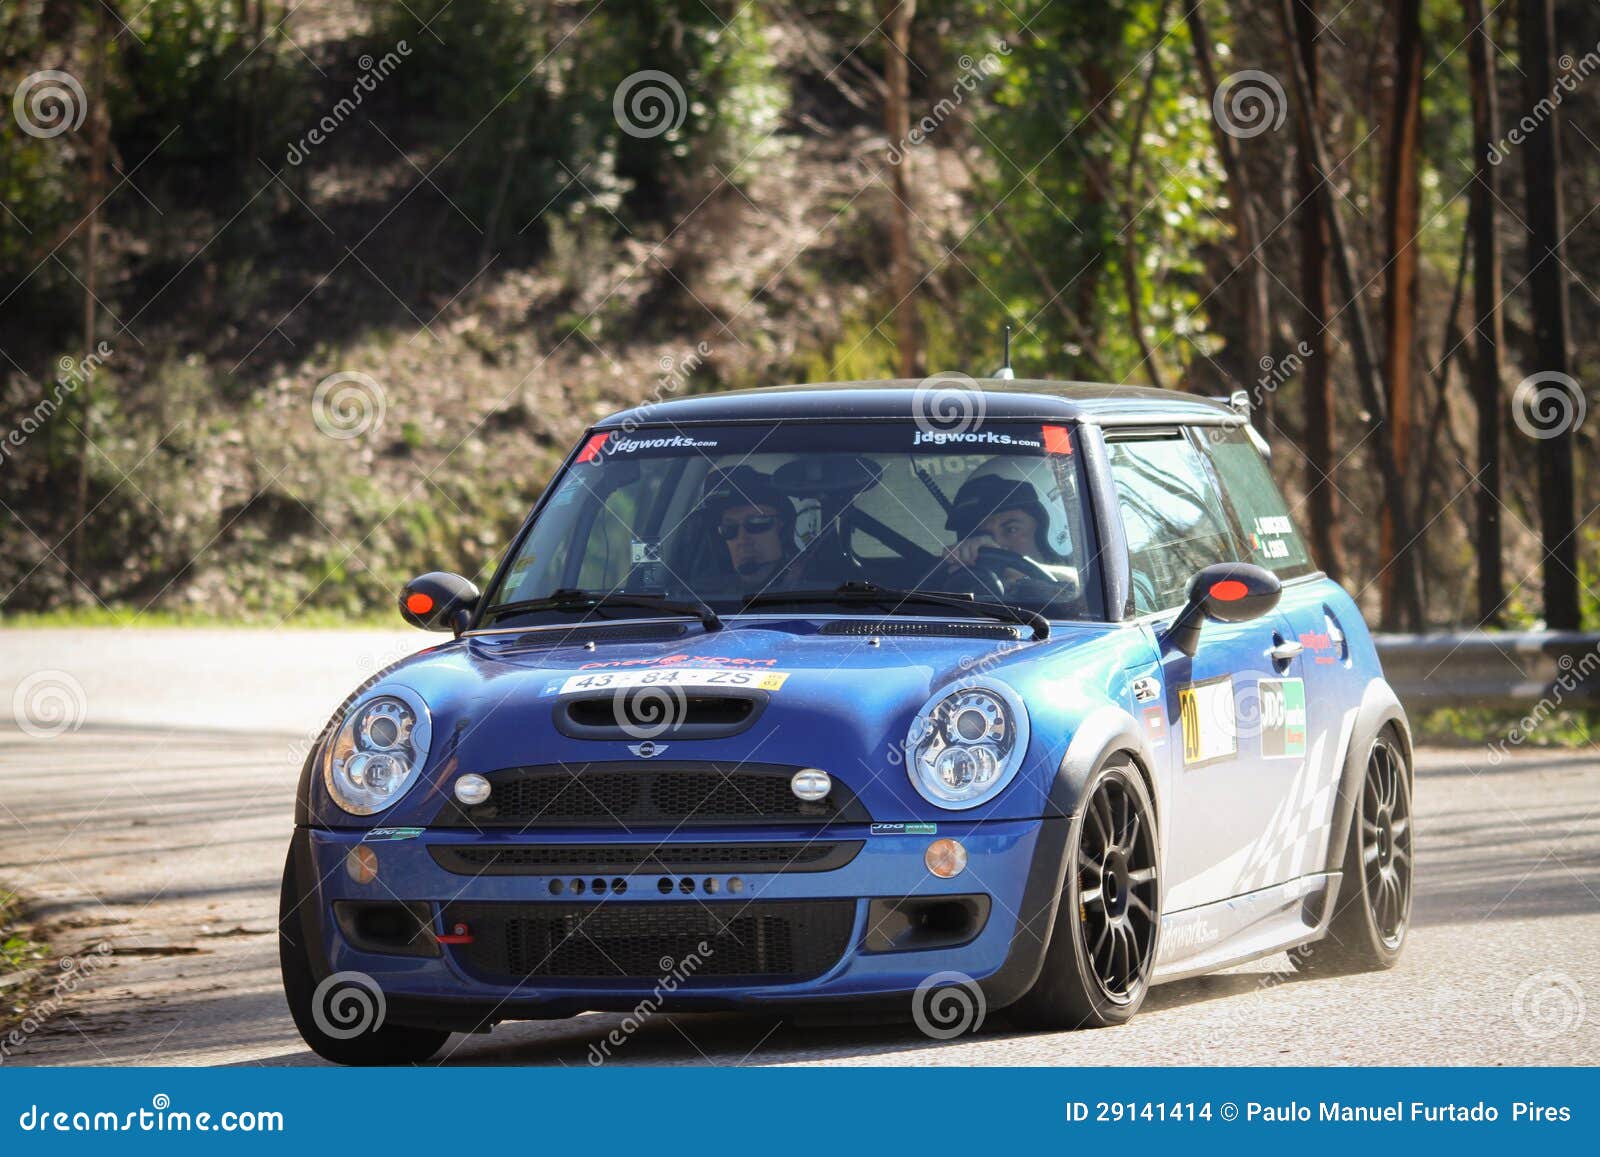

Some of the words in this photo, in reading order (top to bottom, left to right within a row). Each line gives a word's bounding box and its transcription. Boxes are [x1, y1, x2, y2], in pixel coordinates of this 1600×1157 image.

[607, 435, 718, 456] jdgworks.com
[913, 431, 1041, 448] jdgworks.com
[1181, 692, 1200, 760] 20
